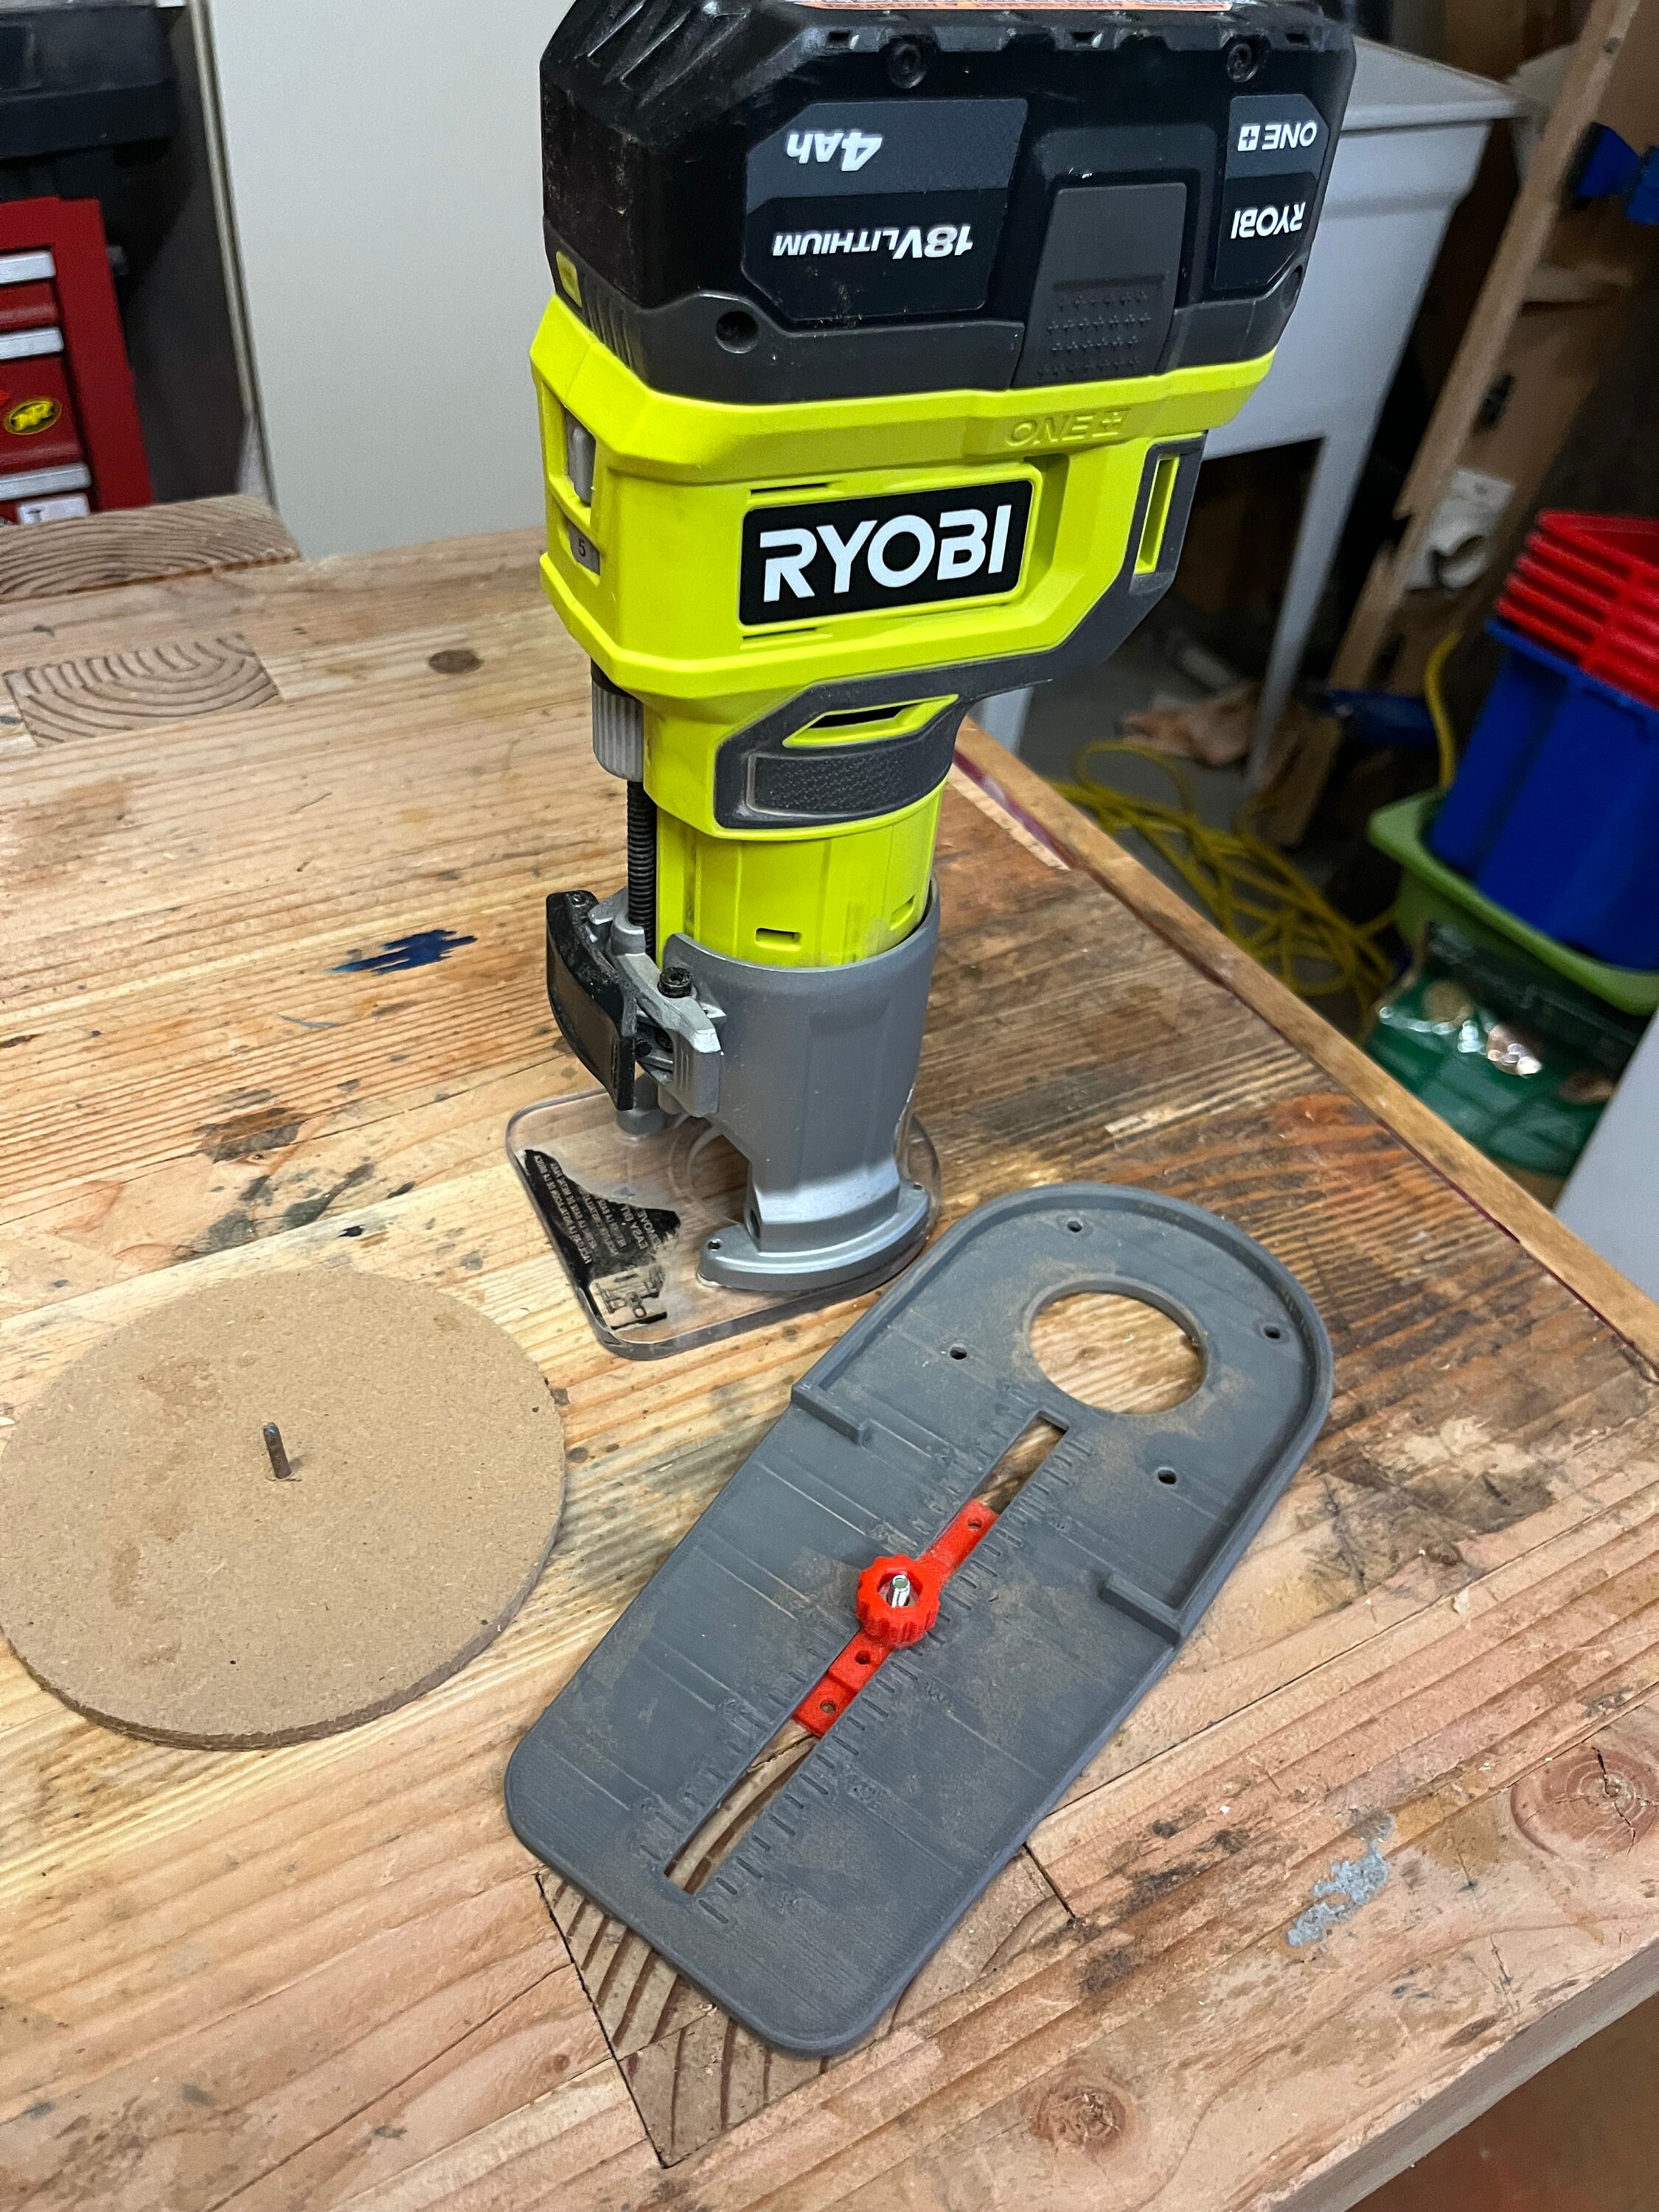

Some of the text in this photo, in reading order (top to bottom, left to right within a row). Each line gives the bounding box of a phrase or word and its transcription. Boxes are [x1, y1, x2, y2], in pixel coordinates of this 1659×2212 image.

[786, 130, 883, 171] 4Ah
[1231, 201, 1306, 240] RYOBI
[578, 538, 585, 557] 5
[760, 504, 1012, 602] RYOBI
